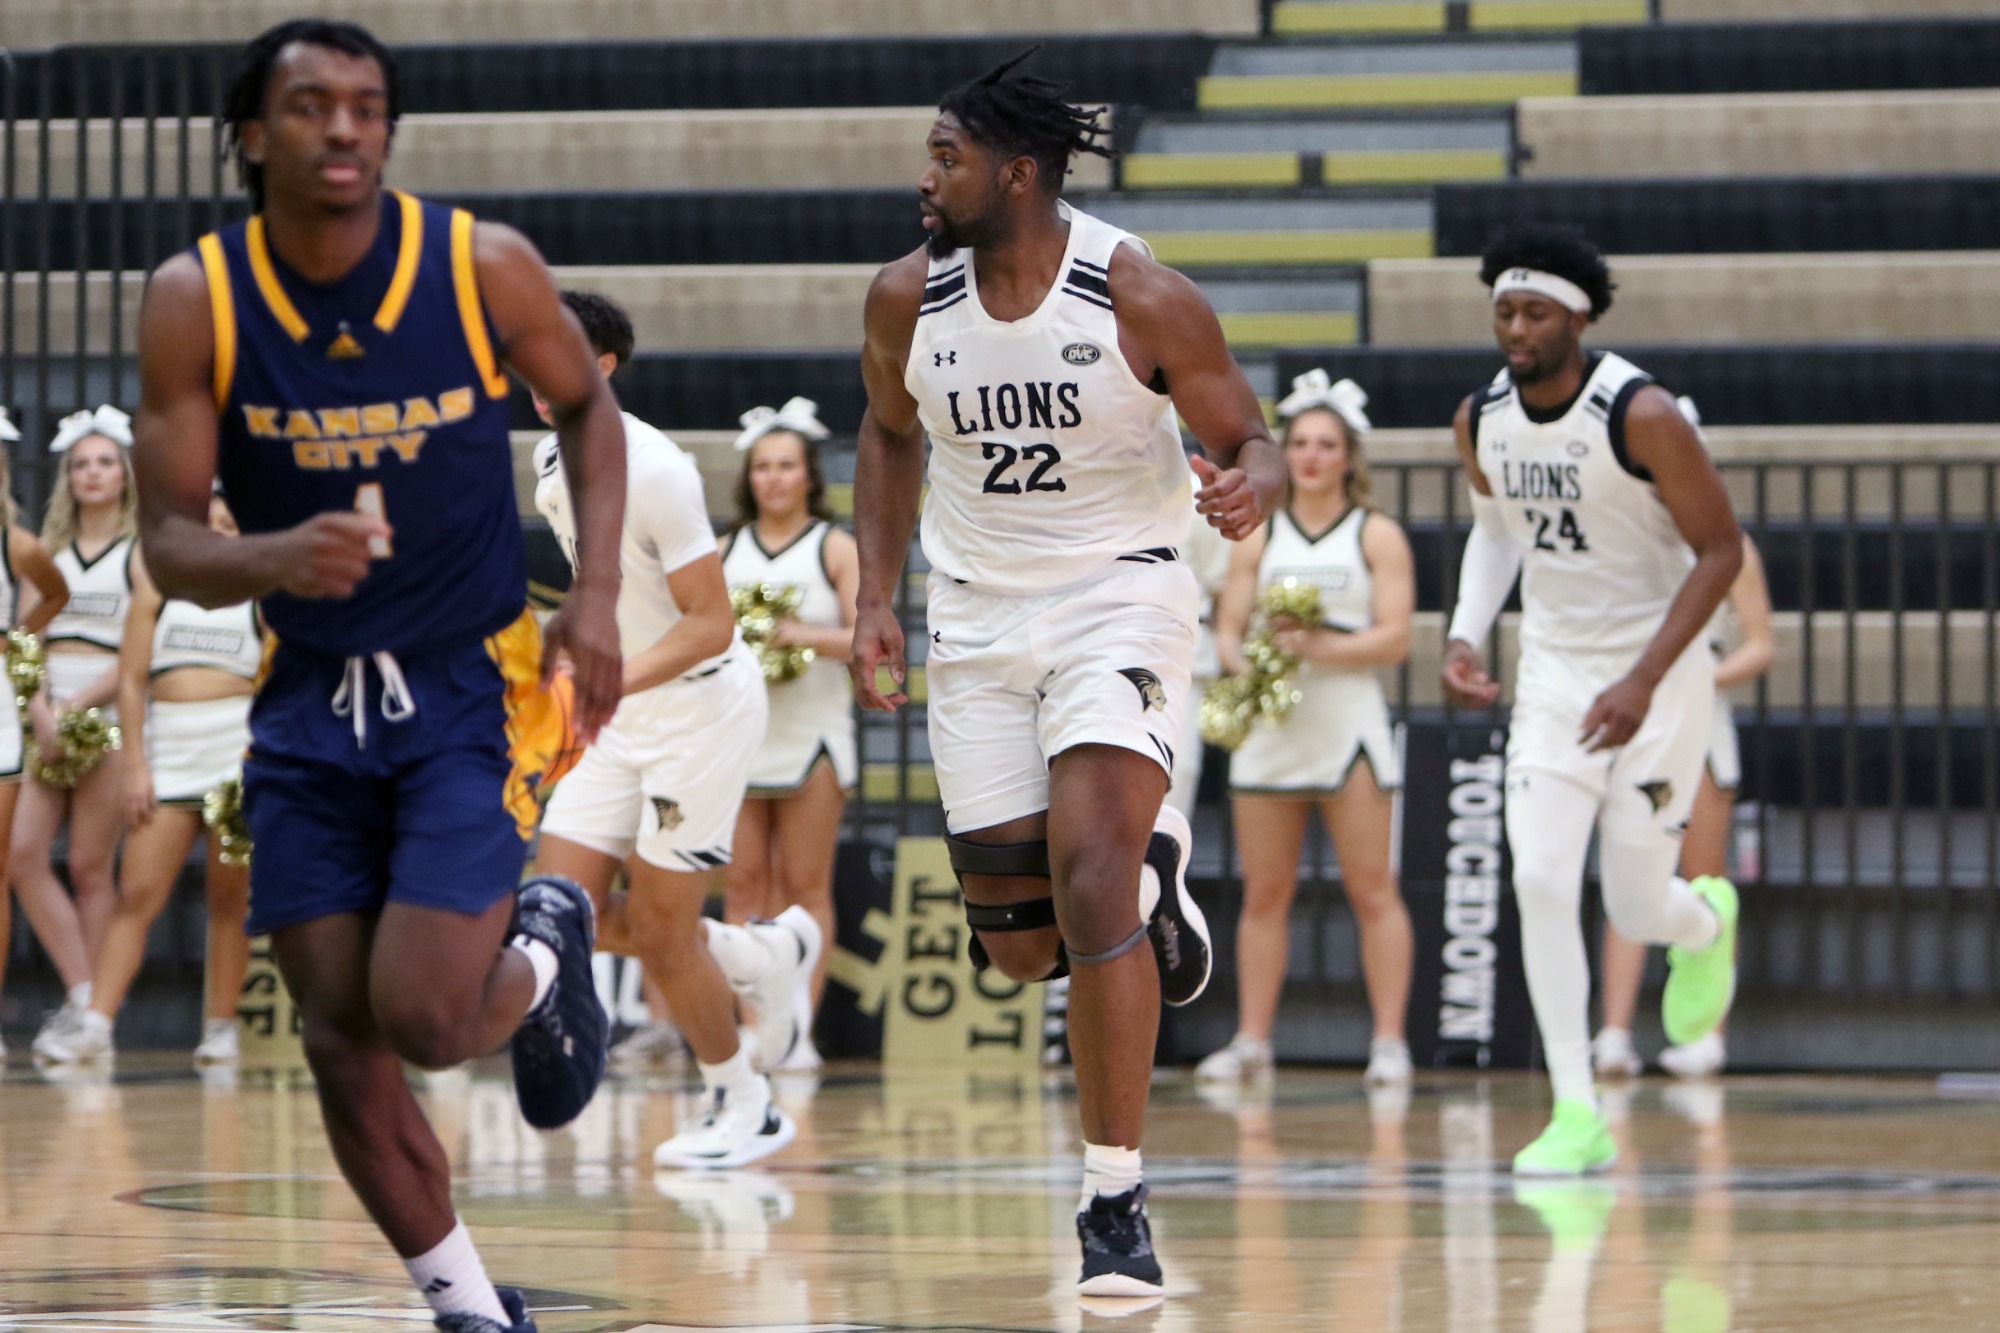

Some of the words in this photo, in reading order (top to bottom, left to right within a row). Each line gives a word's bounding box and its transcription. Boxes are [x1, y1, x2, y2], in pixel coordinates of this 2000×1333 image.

[242, 386, 475, 438] KANSAS
[947, 382, 1082, 435] LIONS
[292, 430, 428, 470] CITY
[982, 442, 1067, 494] 22
[1501, 462, 1581, 500] LIONS
[353, 482, 393, 558] 1
[1524, 507, 1588, 551] 24
[904, 875, 962, 1018] GET
